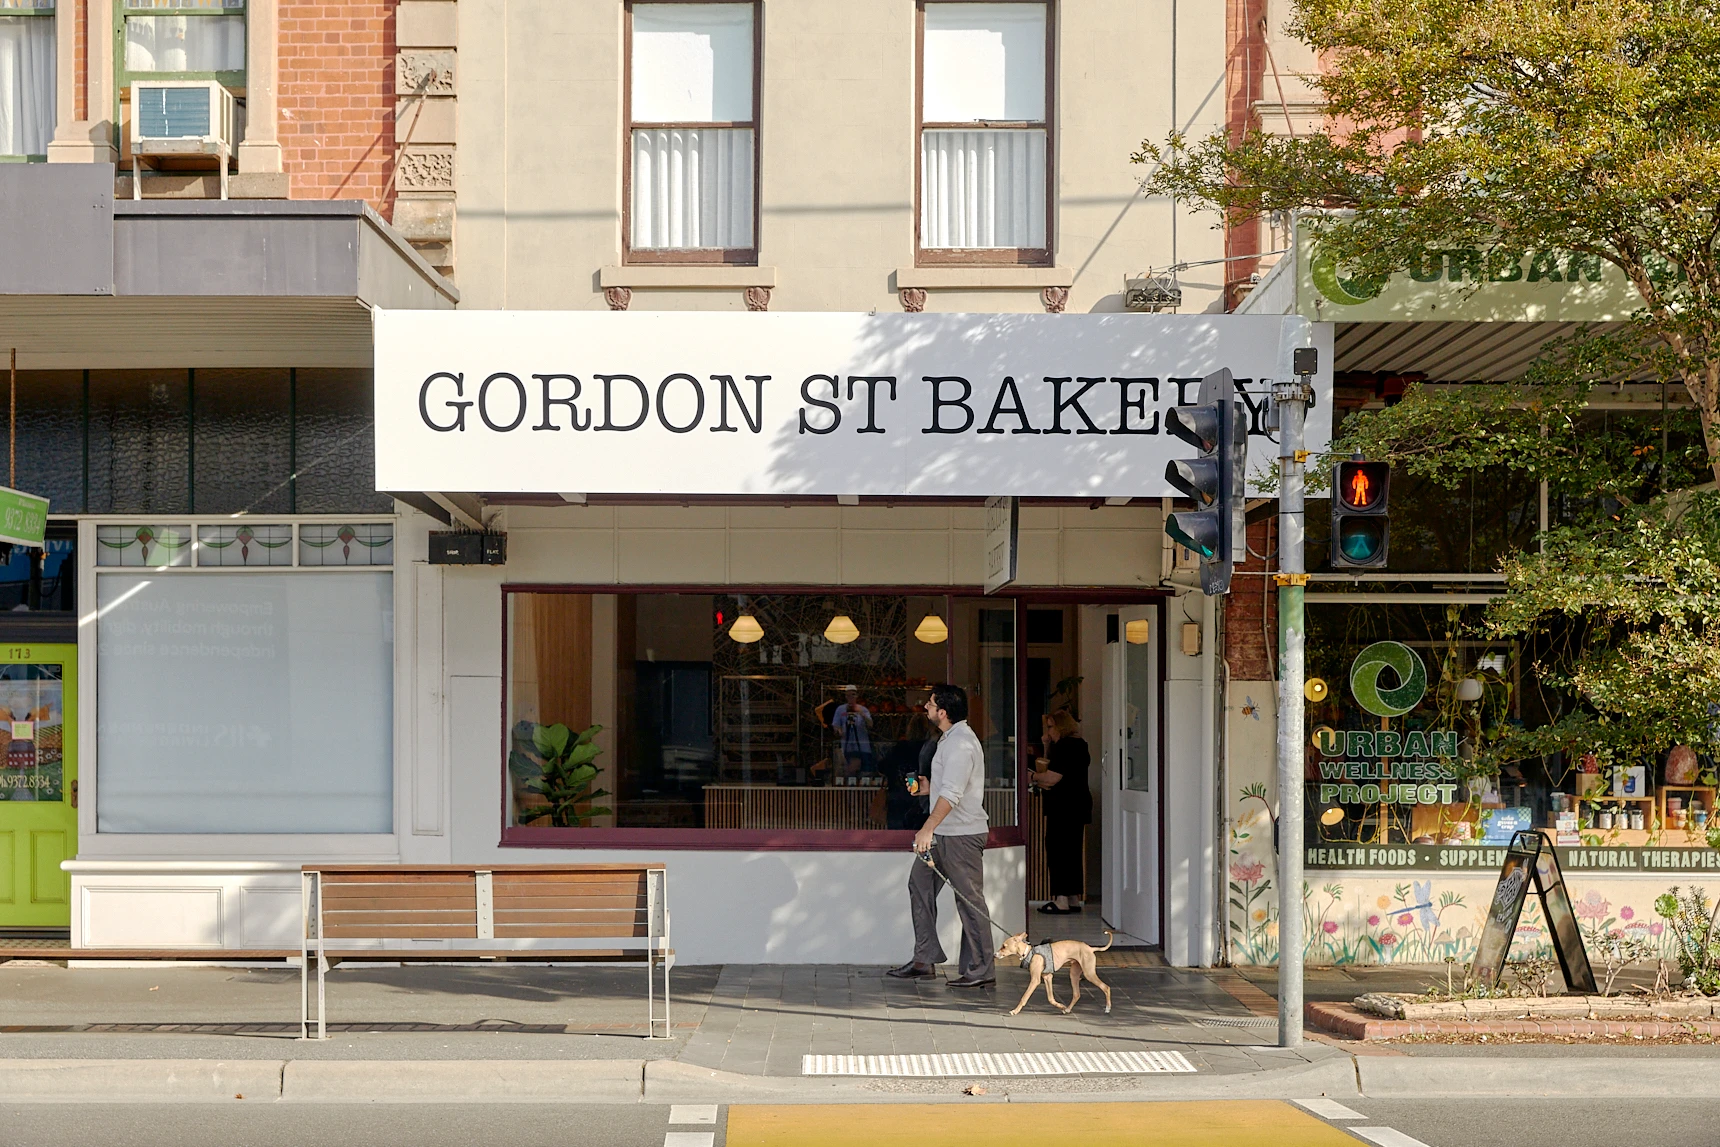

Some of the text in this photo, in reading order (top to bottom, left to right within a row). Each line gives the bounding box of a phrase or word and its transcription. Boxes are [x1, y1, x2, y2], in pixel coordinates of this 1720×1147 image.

[418, 371, 772, 434] GORDON
[798, 373, 897, 435] ST
[9, 648, 31, 659] 173
[1320, 731, 1457, 757] URBAN
[1319, 762, 1457, 780] WELLNESS
[1320, 784, 1458, 804] PROJECT
[1308, 848, 1366, 865] HEALTH
[1369, 848, 1416, 866] FOODS
[1439, 849, 1508, 867] SUPPLEM
[1568, 850, 1637, 867] NATURAL
